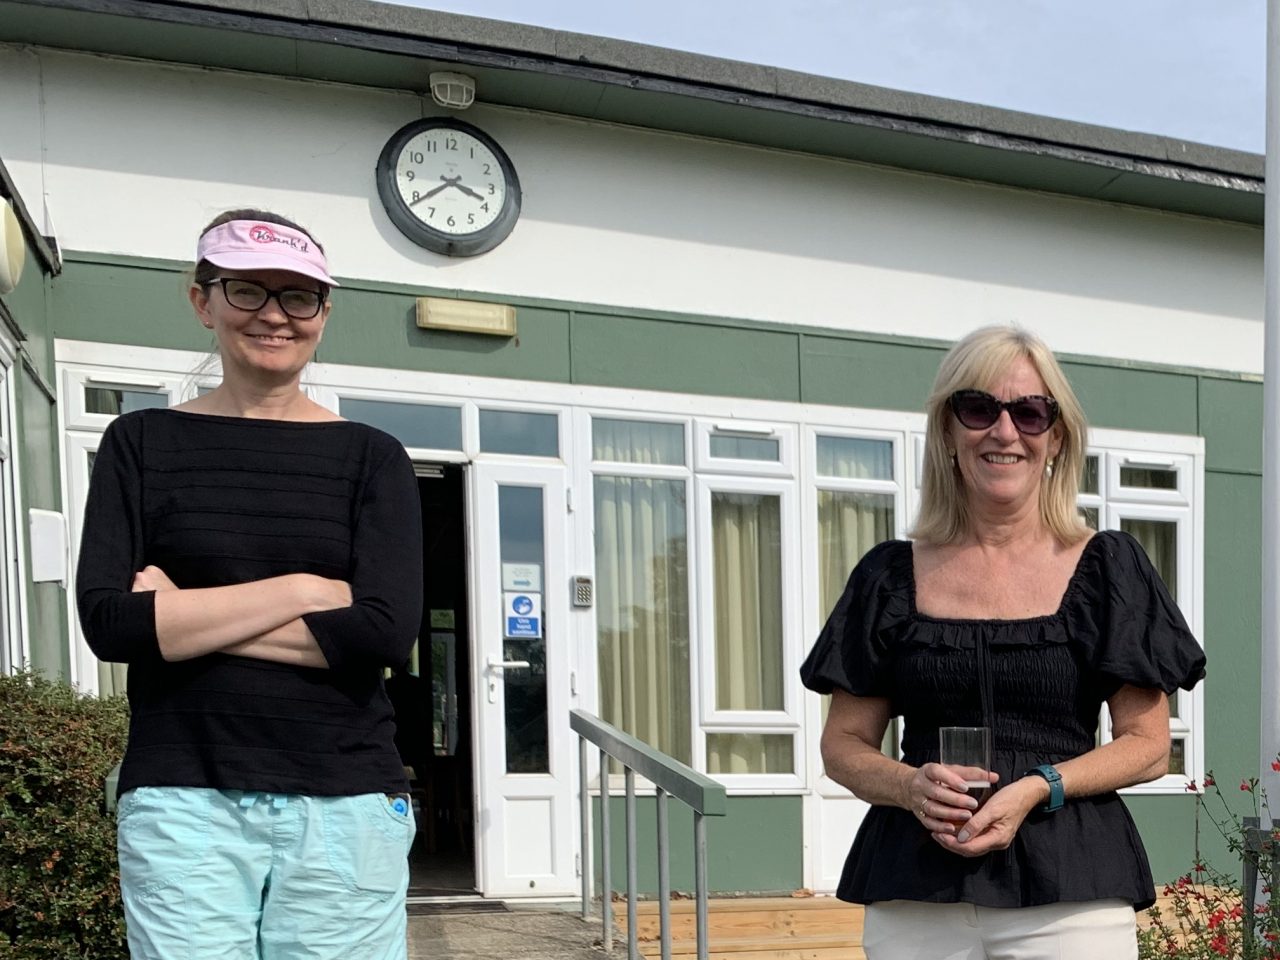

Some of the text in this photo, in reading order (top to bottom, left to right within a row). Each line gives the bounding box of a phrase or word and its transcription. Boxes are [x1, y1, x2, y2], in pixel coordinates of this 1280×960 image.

[427, 140, 437, 153] 11
[446, 138, 458, 151] 12
[410, 151, 424, 164] 10
[406, 170, 415, 182] 9
[483, 163, 491, 176] 2
[412, 190, 420, 202] 8
[488, 183, 495, 196] 3
[428, 206, 436, 219] 7
[480, 201, 489, 214] 4
[447, 215, 456, 227] 6
[467, 213, 475, 225] 5
